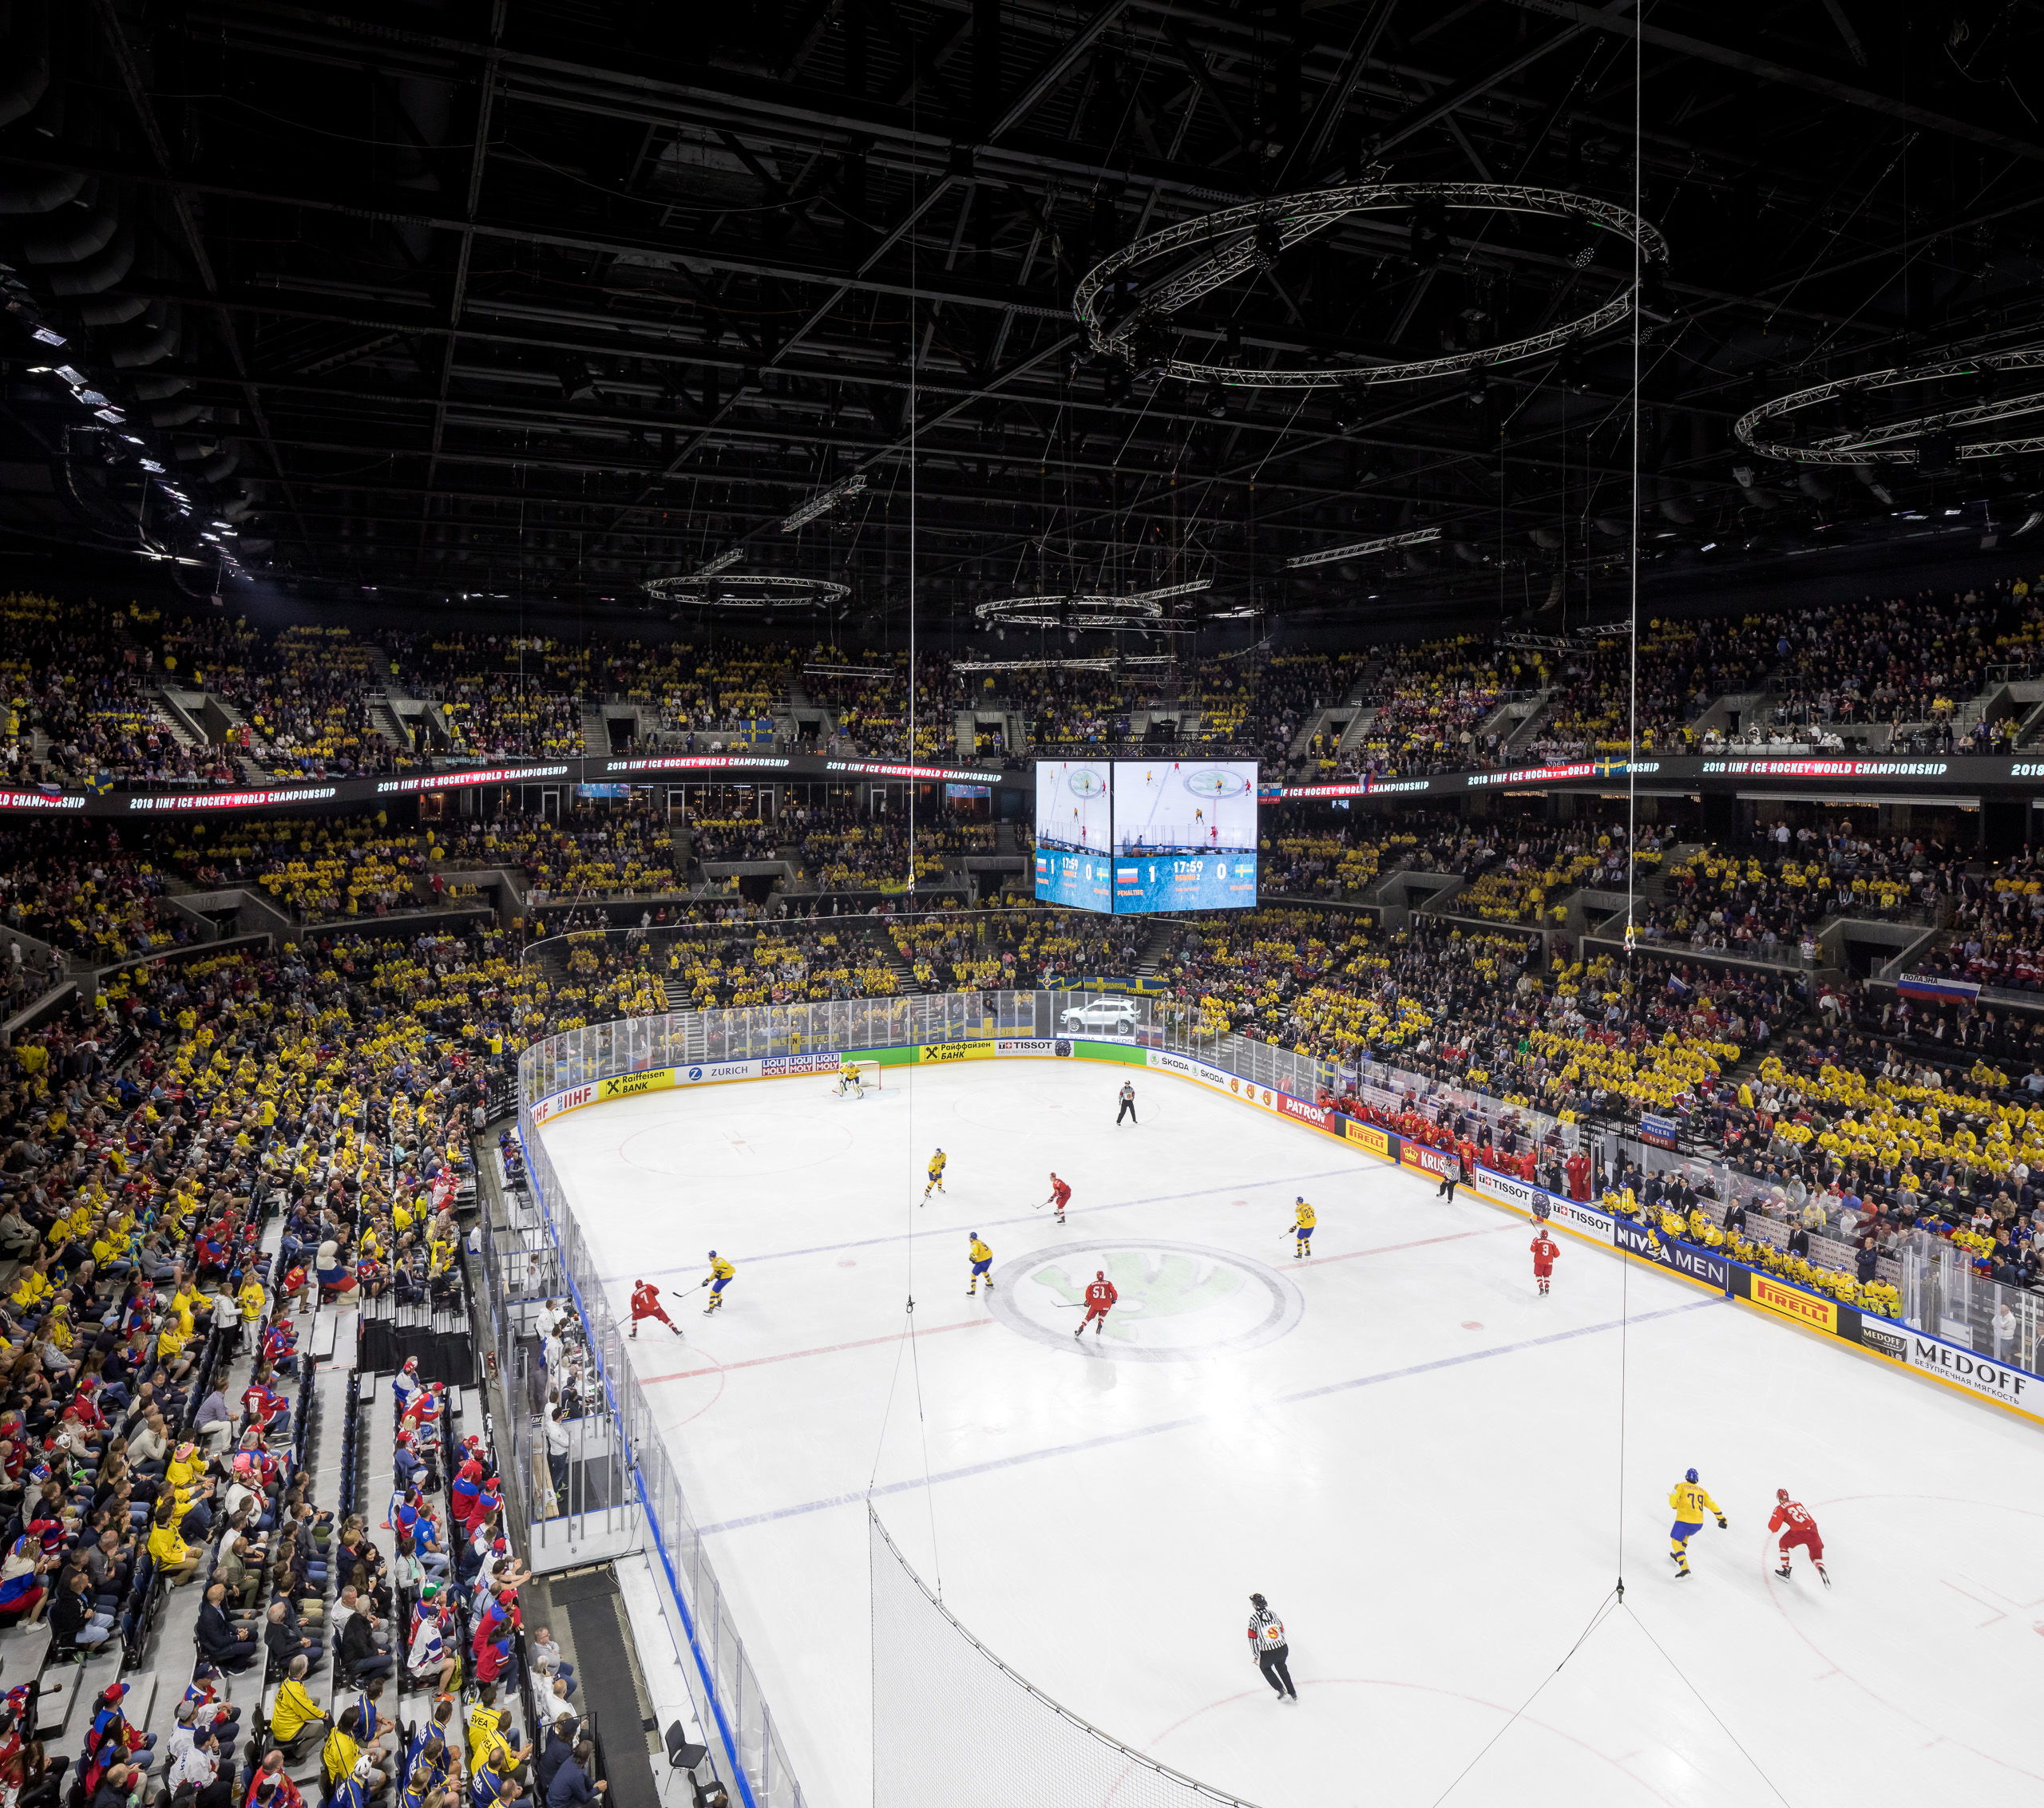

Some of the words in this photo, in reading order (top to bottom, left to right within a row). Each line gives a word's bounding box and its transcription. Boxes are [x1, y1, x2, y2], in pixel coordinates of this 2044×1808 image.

[608, 762, 627, 770] 2018
[1703, 762, 1725, 772] 2018
[1728, 762, 1749, 772] IIHF
[1751, 762, 1767, 772] ICE
[1770, 763, 1812, 773] HOCKEY
[1812, 763, 1852, 773] WORLD
[1856, 763, 1947, 774] CHAMPIONSHIP
[2011, 764, 2044, 776] 2018
[378, 781, 398, 792] 2018
[401, 780, 418, 789] IIHF
[421, 778, 435, 787] ICE
[437, 774, 471, 785] HOCKEY
[472, 772, 501, 781] WORLD
[505, 766, 567, 779] CHAMPIONSHIP
[943, 770, 1001, 781] CHAMPIONSHIP
[1468, 776, 1487, 785] 2018
[1491, 773, 1507, 783] IIHF
[1510, 772, 1523, 781] ICE
[1305, 787, 1337, 796] HOCKEY
[1369, 781, 1428, 793] CHAMPIONSHIP
[130, 798, 153, 809] 2018
[156, 798, 175, 808] IIHF
[178, 797, 193, 807] ICE
[196, 796, 232, 806] HOCKEY
[233, 793, 265, 804] WORLD
[268, 788, 335, 802] CHAMPIONSHIP
[1051, 859, 1054, 874] 1
[1063, 857, 1078, 869] 17:59
[1174, 860, 1203, 872] 17:59
[1086, 864, 1091, 880] 0
[1149, 865, 1155, 882] 1
[1217, 863, 1226, 880] 0
[200, 896, 217, 908] 107
[1601, 896, 1617, 908] 114
[941, 1042, 991, 1051] Райффайзен
[789, 1057, 812, 1066] LIQUI
[816, 1054, 838, 1063] LIQUI
[941, 1051, 965, 1060] БАНК
[763, 1059, 786, 1068] LIQUI
[789, 1064, 813, 1074] MOLY
[816, 1062, 839, 1071] MOLY
[1162, 1057, 1190, 1070] ŠKODA
[622, 1070, 665, 1084] Raiffeisen
[711, 1066, 748, 1076] ZURICH
[763, 1067, 786, 1076] MOLY
[1200, 1069, 1224, 1084] ŠKODA
[623, 1082, 648, 1094] BANK
[564, 1087, 592, 1108] IIHF
[1286, 1098, 1325, 1124] PATRON
[1349, 1124, 1384, 1149] PIRELLI
[1421, 1149, 1445, 1173] KRUŠ
[1491, 1187, 1507, 1198] WATCHES
[1492, 1176, 1530, 1201] TISSOT
[1566, 1217, 1586, 1230] WATCHES
[1570, 1209, 1612, 1232] TISSOT
[1745, 1213, 1768, 1223] HATE-M.RU
[1542, 1244, 1549, 1256] 3
[1811, 1241, 1836, 1254] SHATE-M.RU
[1825, 1240, 1852, 1252] SHATE-M.RU
[1824, 1254, 1852, 1266] SHATE-M.RU
[1676, 1251, 1724, 1284] MEN
[640, 1292, 649, 1304] 7
[1092, 1286, 1106, 1299] 51
[1757, 1280, 1829, 1323] PIRELLI
[1863, 1327, 1901, 1345] MEDOFF
[1916, 1338, 2026, 1395] MEDOFF
[1915, 1358, 1971, 1386] БЕЗУПРЕЧНАЯ
[1974, 1381, 2020, 1405] МЯГКОСТЬ
[1687, 1493, 1704, 1511] 79
[1788, 1505, 1811, 1523] 29
[471, 1715, 488, 1727] SVEA
